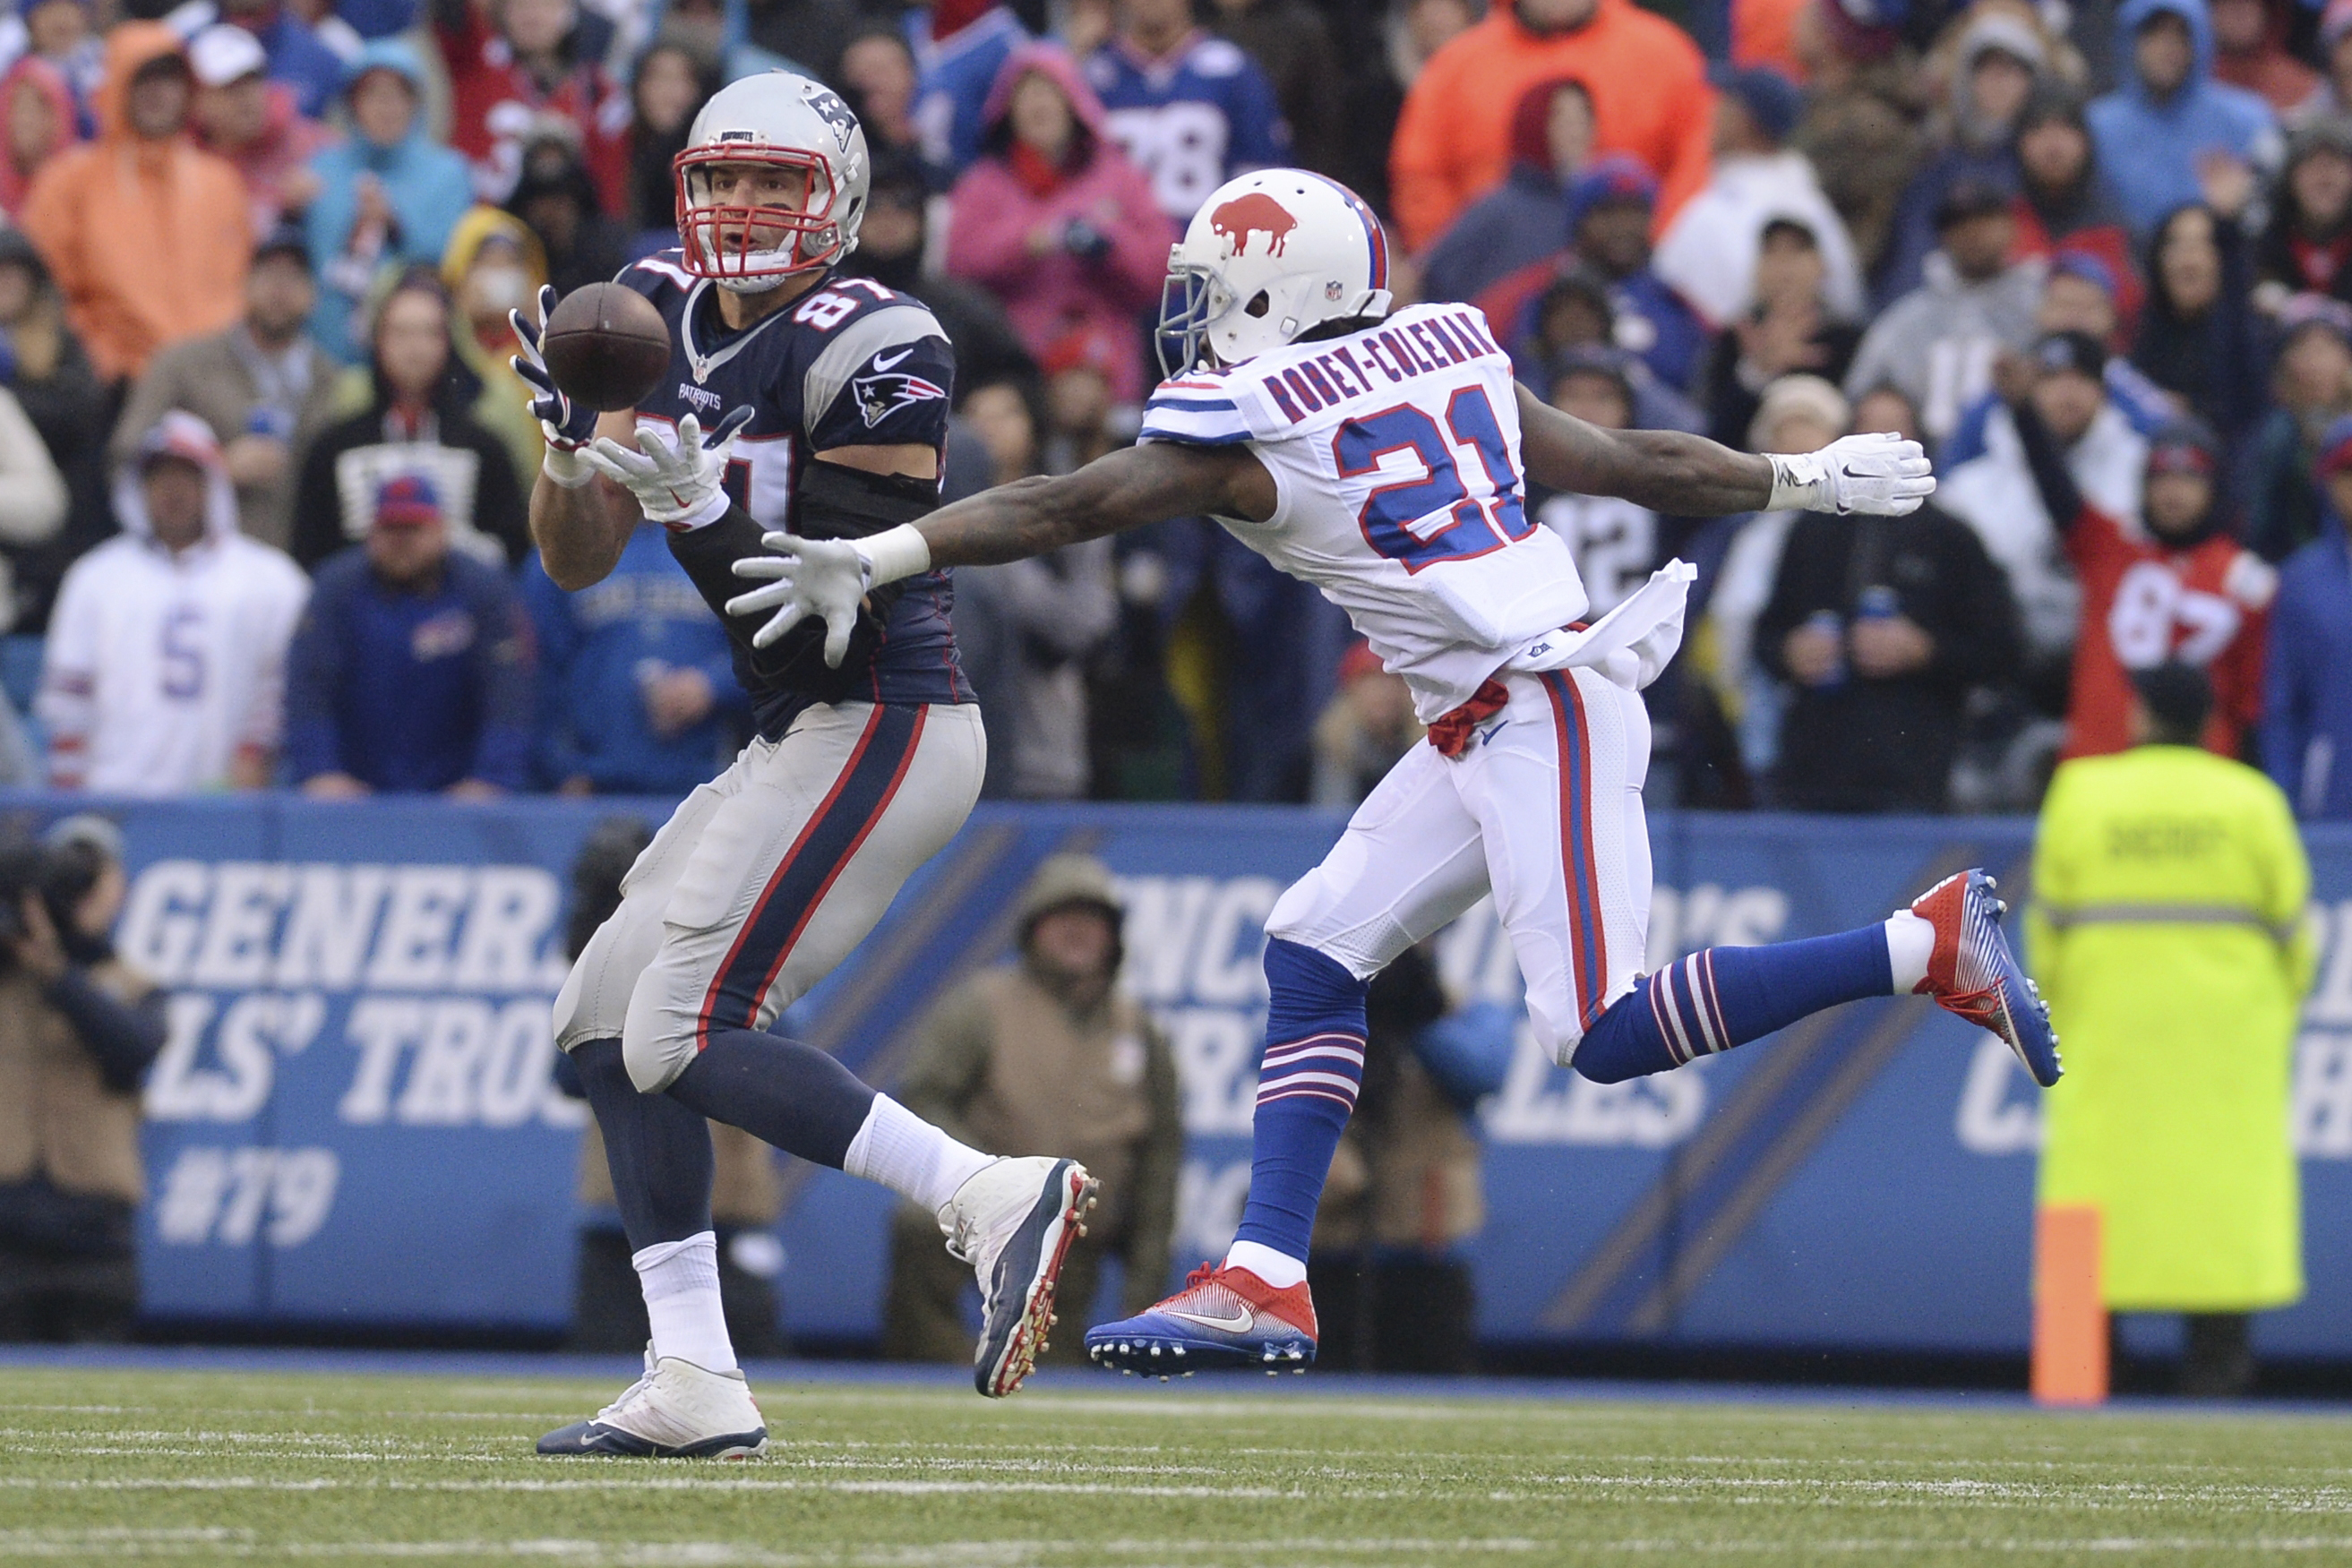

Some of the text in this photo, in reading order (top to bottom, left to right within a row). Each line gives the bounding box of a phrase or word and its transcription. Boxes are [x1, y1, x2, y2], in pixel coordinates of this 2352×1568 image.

[1103, 106, 1231, 215] 78
[793, 278, 896, 332] 87
[678, 382, 722, 410] PATRIOTS
[1331, 384, 1538, 576] 21
[159, 605, 208, 703] 5
[2108, 559, 2239, 669] 87
[115, 861, 575, 990] GENER
